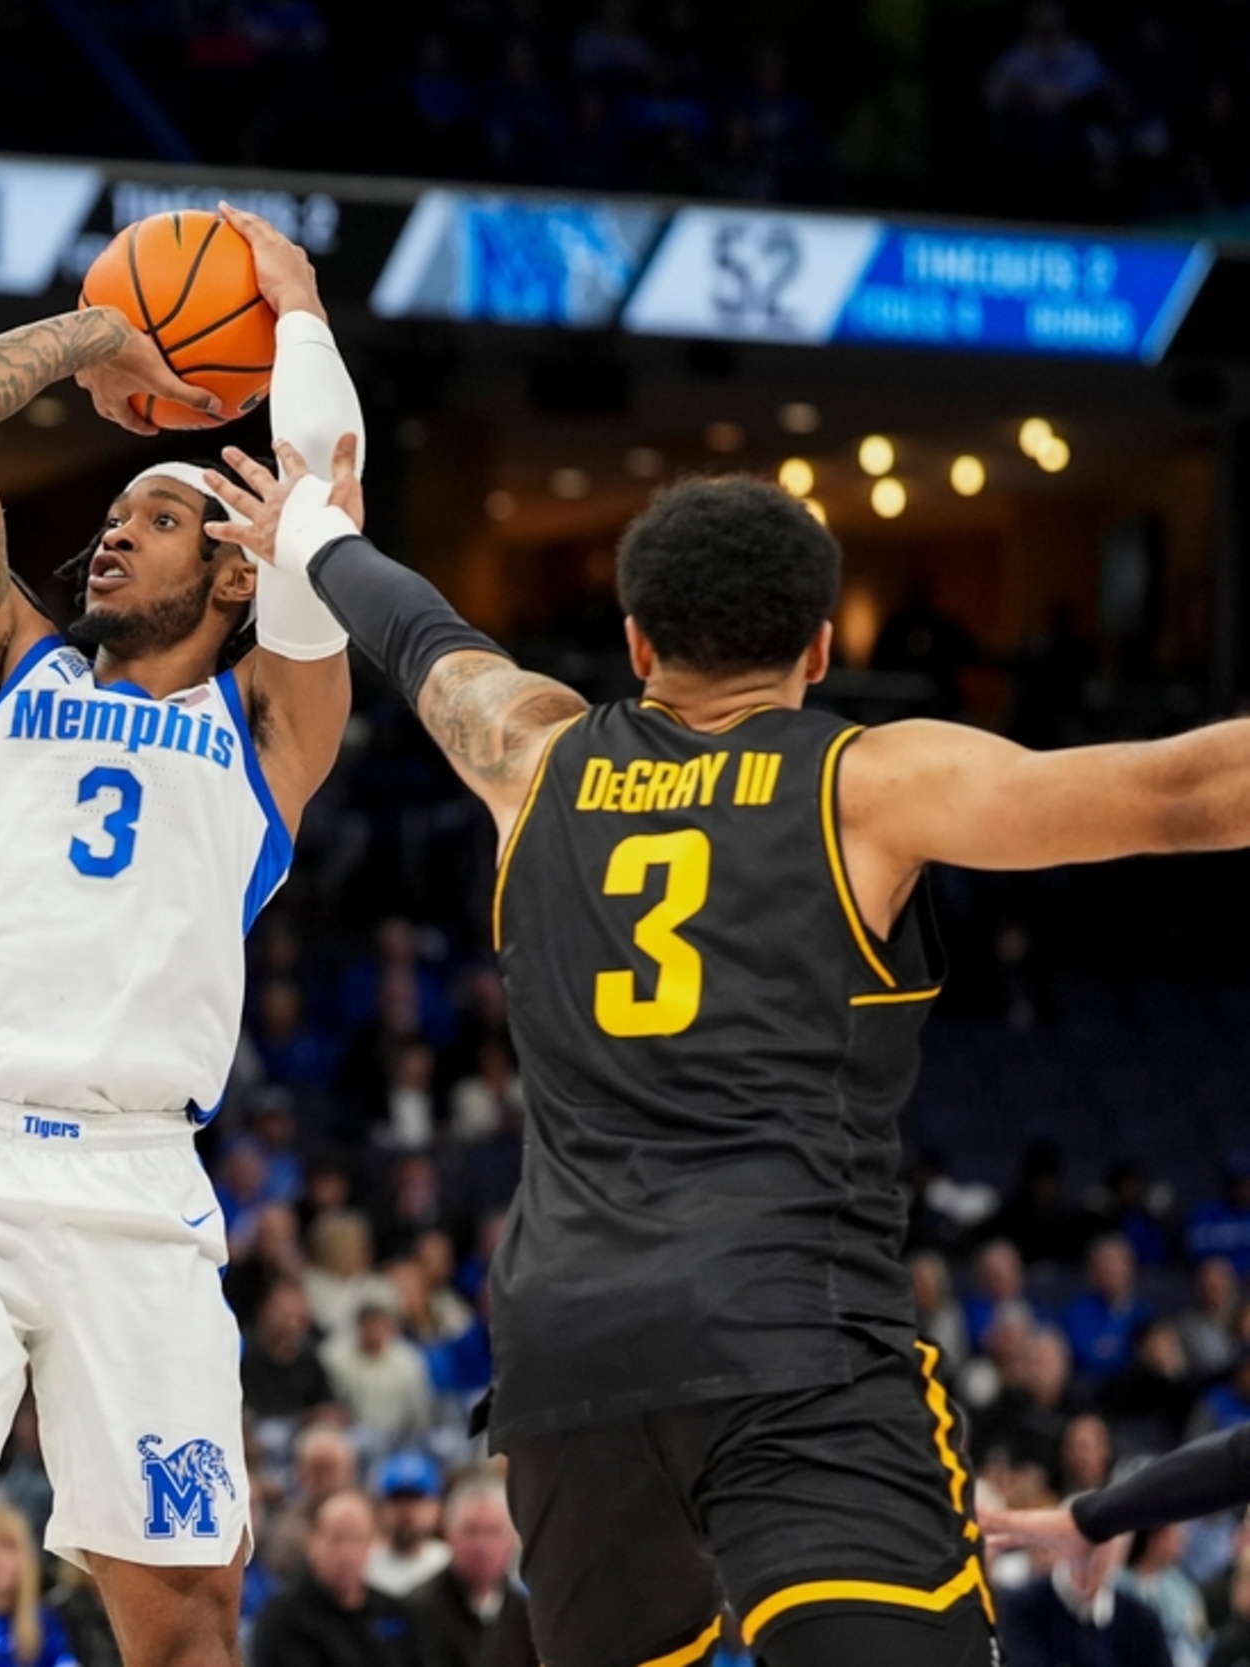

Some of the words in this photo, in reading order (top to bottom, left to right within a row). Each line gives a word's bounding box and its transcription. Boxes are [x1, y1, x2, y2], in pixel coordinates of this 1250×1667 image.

[712, 216, 803, 324] 52
[6, 688, 235, 770] Memphis
[68, 765, 144, 879] 3
[575, 751, 729, 813] DeGRAY
[733, 752, 783, 806] III
[594, 828, 711, 1038] 3
[23, 1115, 81, 1139] Tigers
